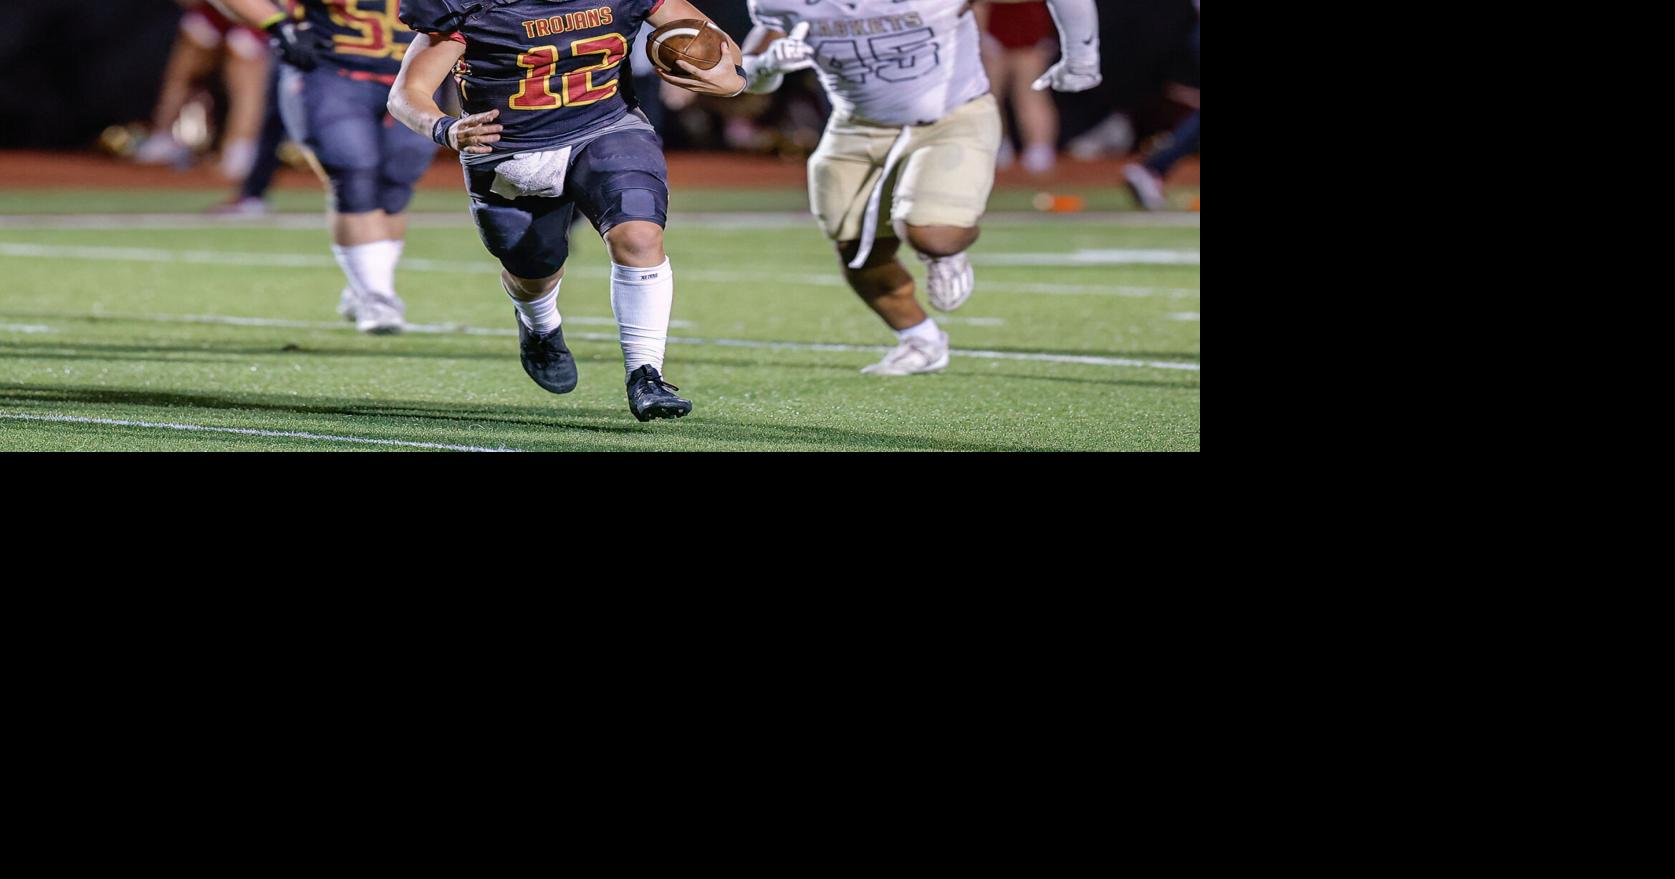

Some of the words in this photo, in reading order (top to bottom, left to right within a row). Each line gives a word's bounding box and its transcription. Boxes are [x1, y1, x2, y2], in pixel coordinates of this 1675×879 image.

[522, 6, 613, 39] TROJANS
[508, 32, 628, 110] 12
[815, 26, 940, 84] 45
